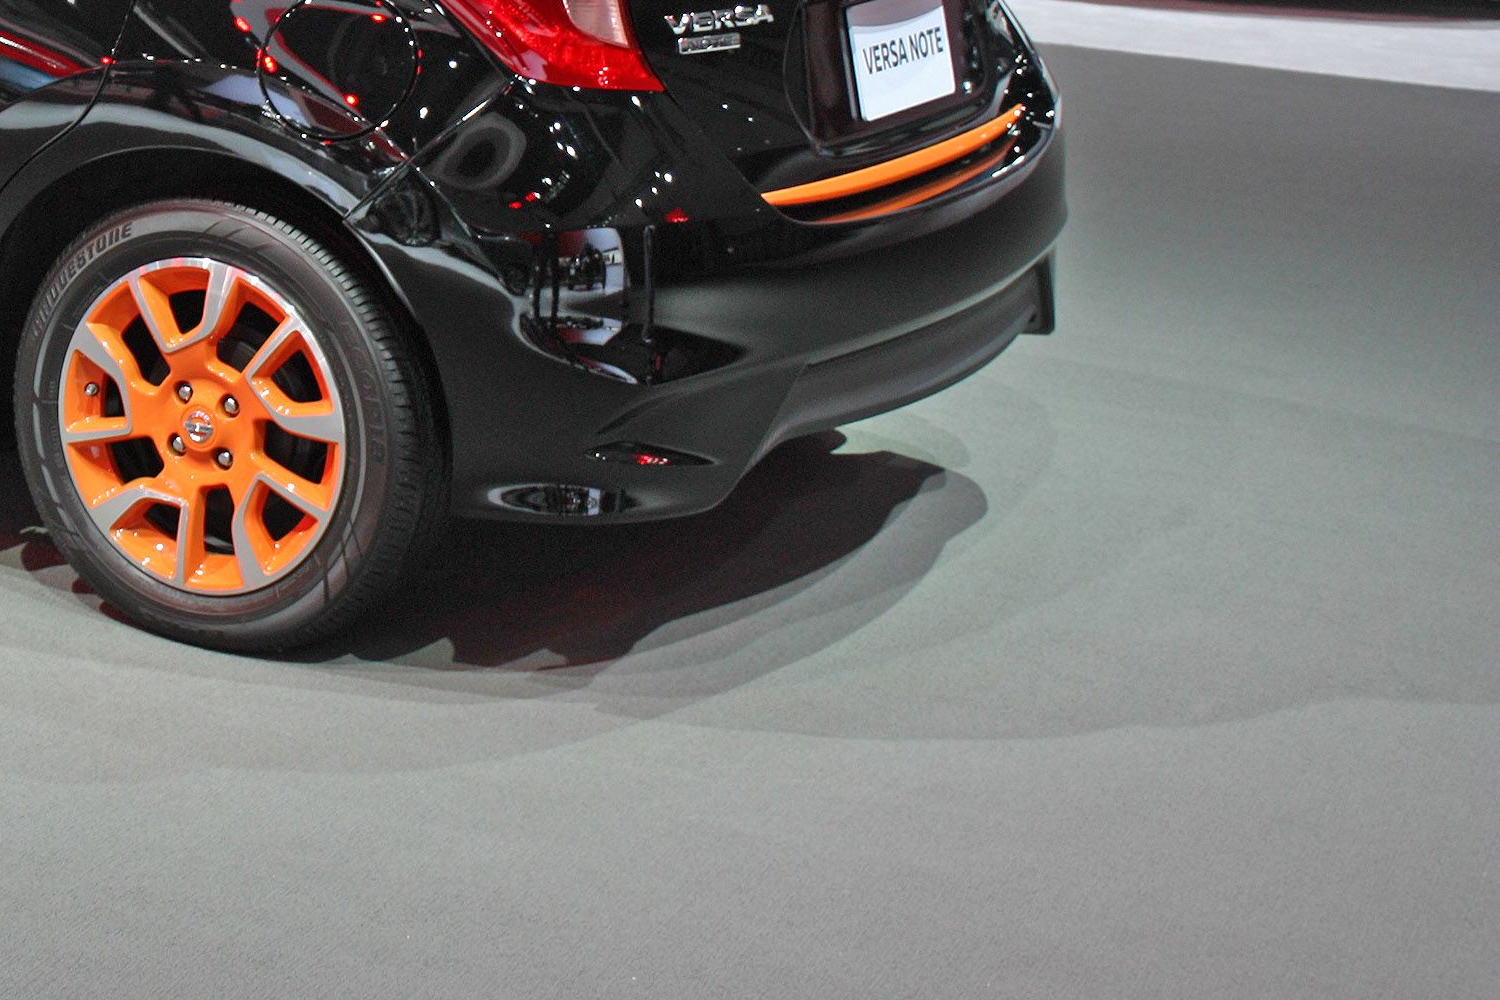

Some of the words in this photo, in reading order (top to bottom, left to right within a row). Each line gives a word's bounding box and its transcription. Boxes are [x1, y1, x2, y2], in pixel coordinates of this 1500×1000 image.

[663, 3, 774, 34] VERSA
[862, 37, 908, 75] VERSA
[908, 26, 944, 62] NOTE
[31, 219, 134, 339] BRIDGESTONE
